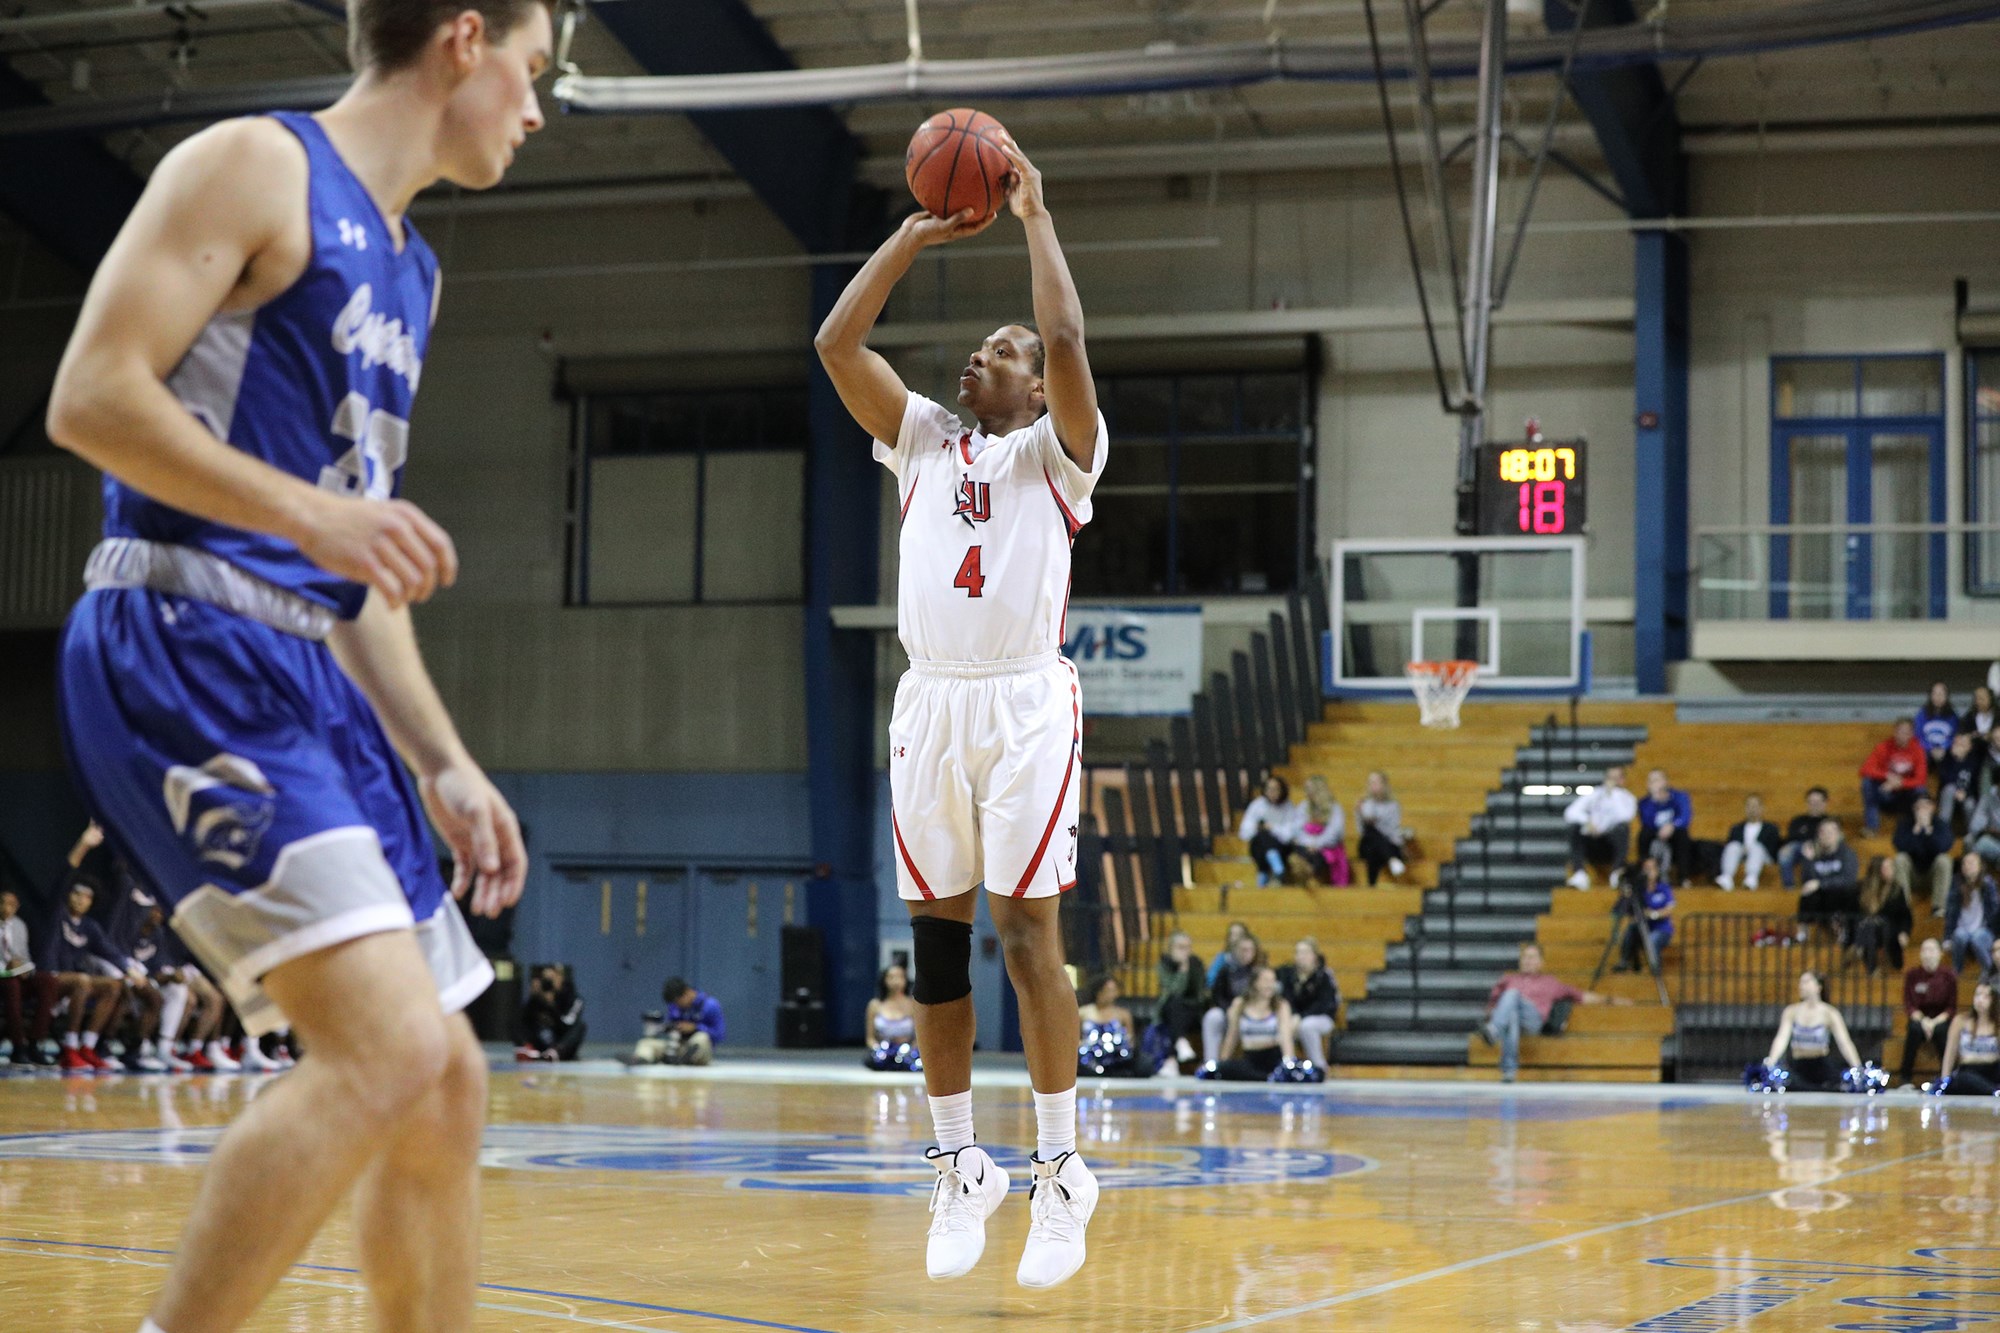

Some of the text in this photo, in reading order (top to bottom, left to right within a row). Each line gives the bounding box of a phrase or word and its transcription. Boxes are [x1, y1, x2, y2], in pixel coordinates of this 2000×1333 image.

[1500, 448, 1575, 482] 18:07
[1519, 480, 1565, 533] 18
[953, 545, 985, 597] 4
